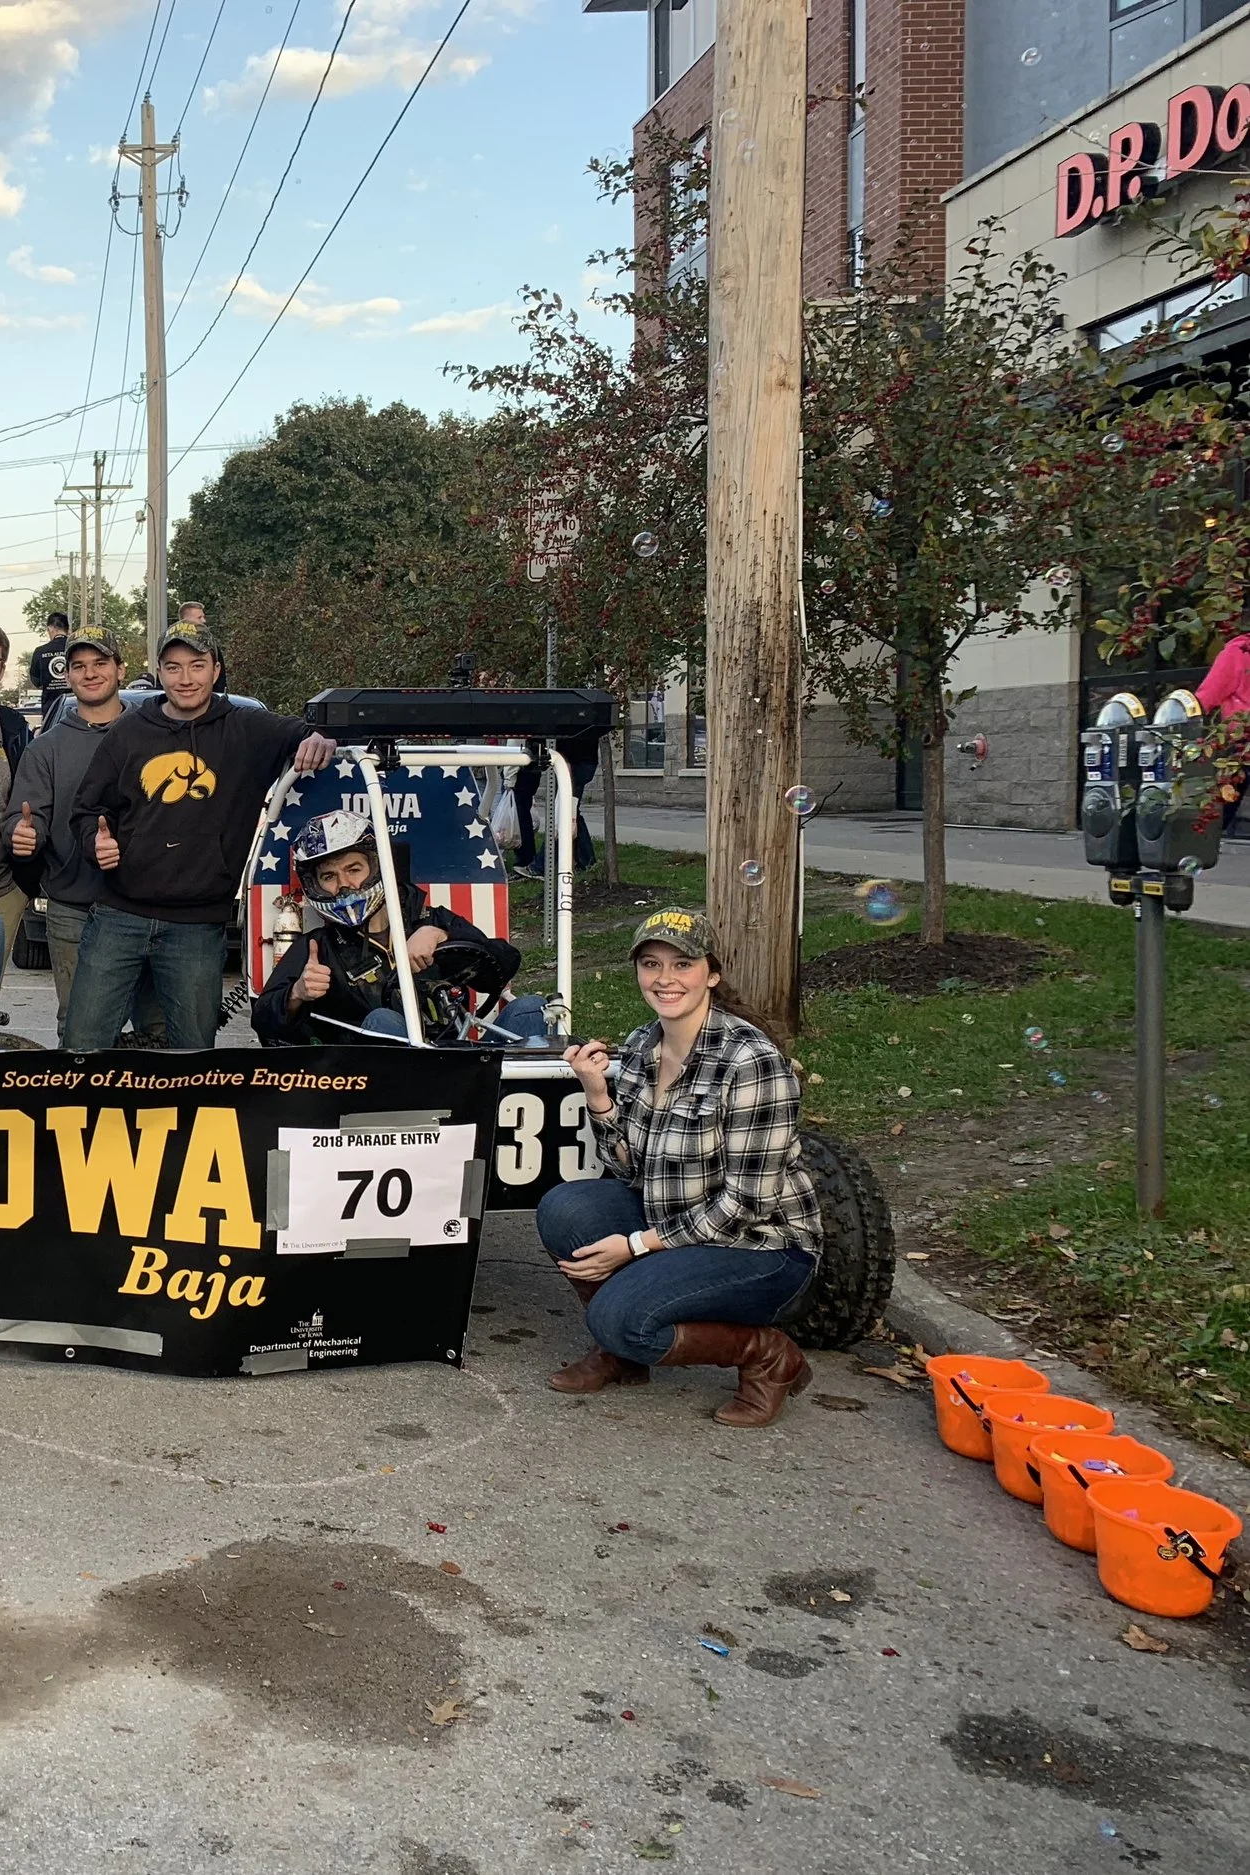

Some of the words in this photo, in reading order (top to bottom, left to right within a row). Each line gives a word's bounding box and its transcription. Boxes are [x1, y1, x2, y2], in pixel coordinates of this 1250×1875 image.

[1055, 122, 1141, 238] D.P.
[341, 793, 422, 818] IOWA
[387, 821, 408, 835] aja
[646, 912, 692, 929] IOWA
[2, 1070, 85, 1089] Society
[90, 1069, 116, 1087] of
[116, 1069, 244, 1091] Automotive
[250, 1068, 368, 1092] Engineers
[312, 1135, 343, 1148] 2018
[348, 1133, 397, 1147] PARADE
[401, 1132, 441, 1145] ENTRY
[496, 1092, 604, 1185] 33
[337, 1168, 413, 1220] 70
[118, 1245, 266, 1319] Baja
[290, 1325, 324, 1334] UNIVERSITY
[250, 1341, 300, 1353] Department
[303, 1340, 311, 1349] of
[313, 1336, 362, 1348] Mechanical
[309, 1347, 358, 1359] Engineering
